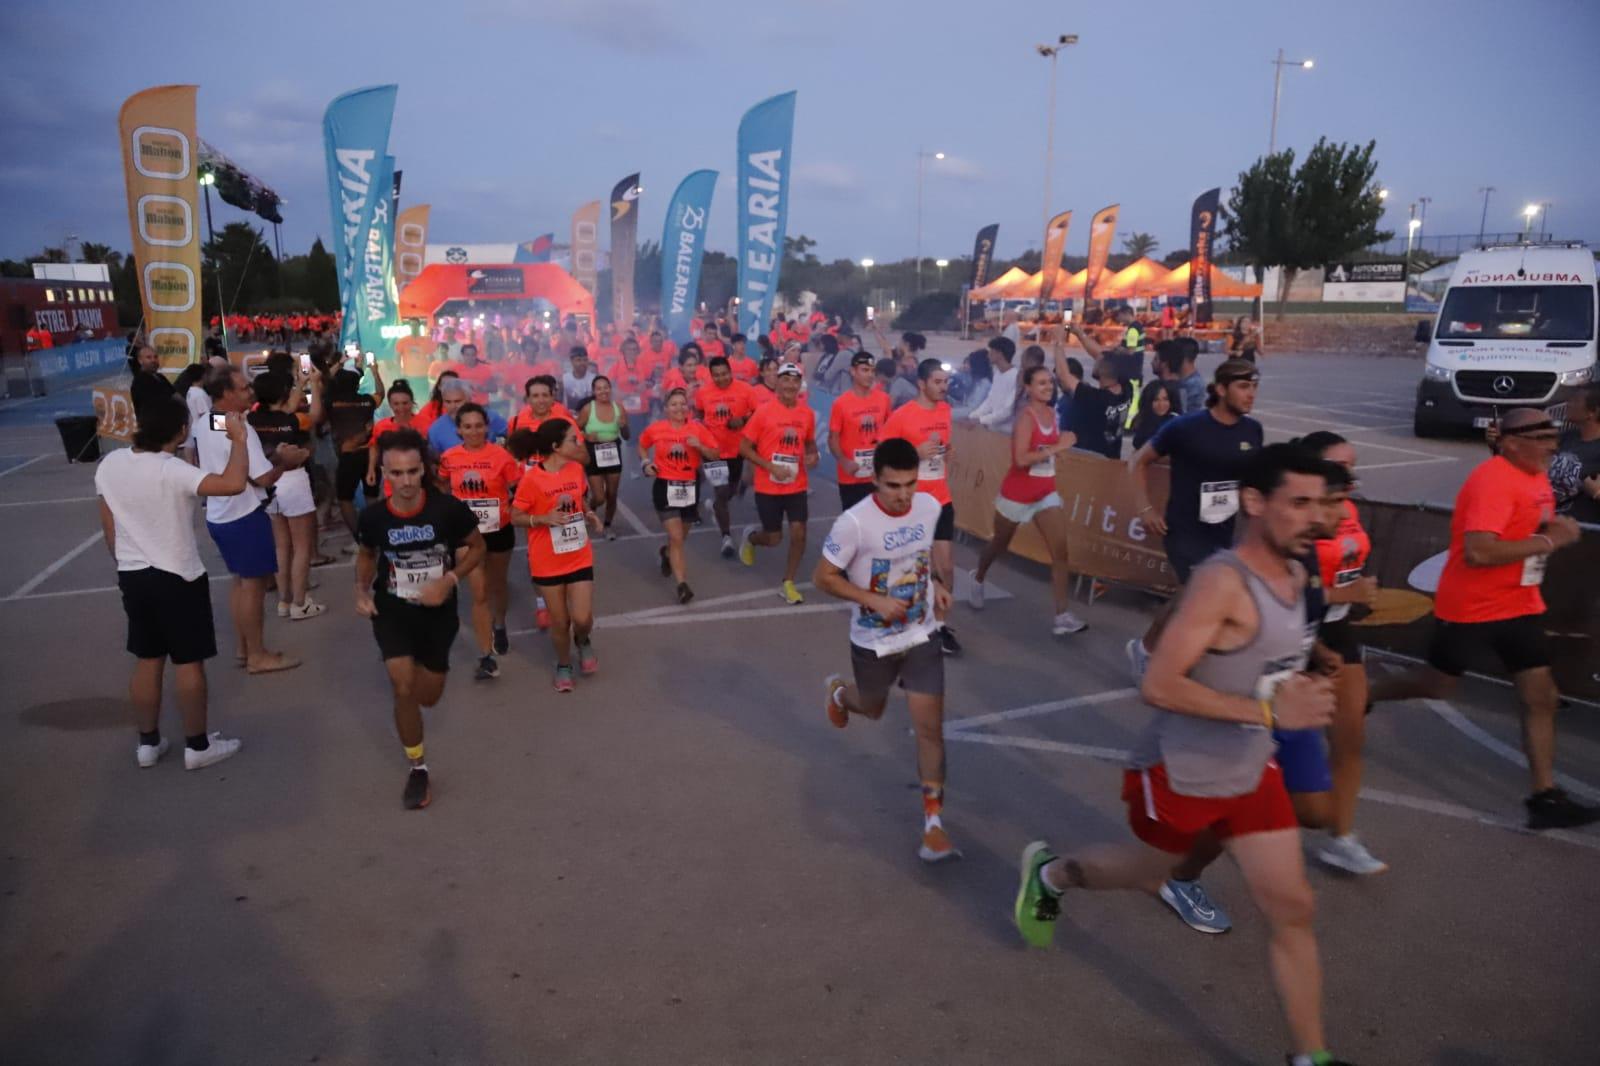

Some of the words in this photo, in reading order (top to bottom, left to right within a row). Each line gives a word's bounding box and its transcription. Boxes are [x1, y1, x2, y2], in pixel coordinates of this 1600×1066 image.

[670, 230, 695, 314] BALEARIA
[561, 526, 578, 538] 473
[1069, 493, 1148, 541] lite
[407, 571, 429, 584] 977
